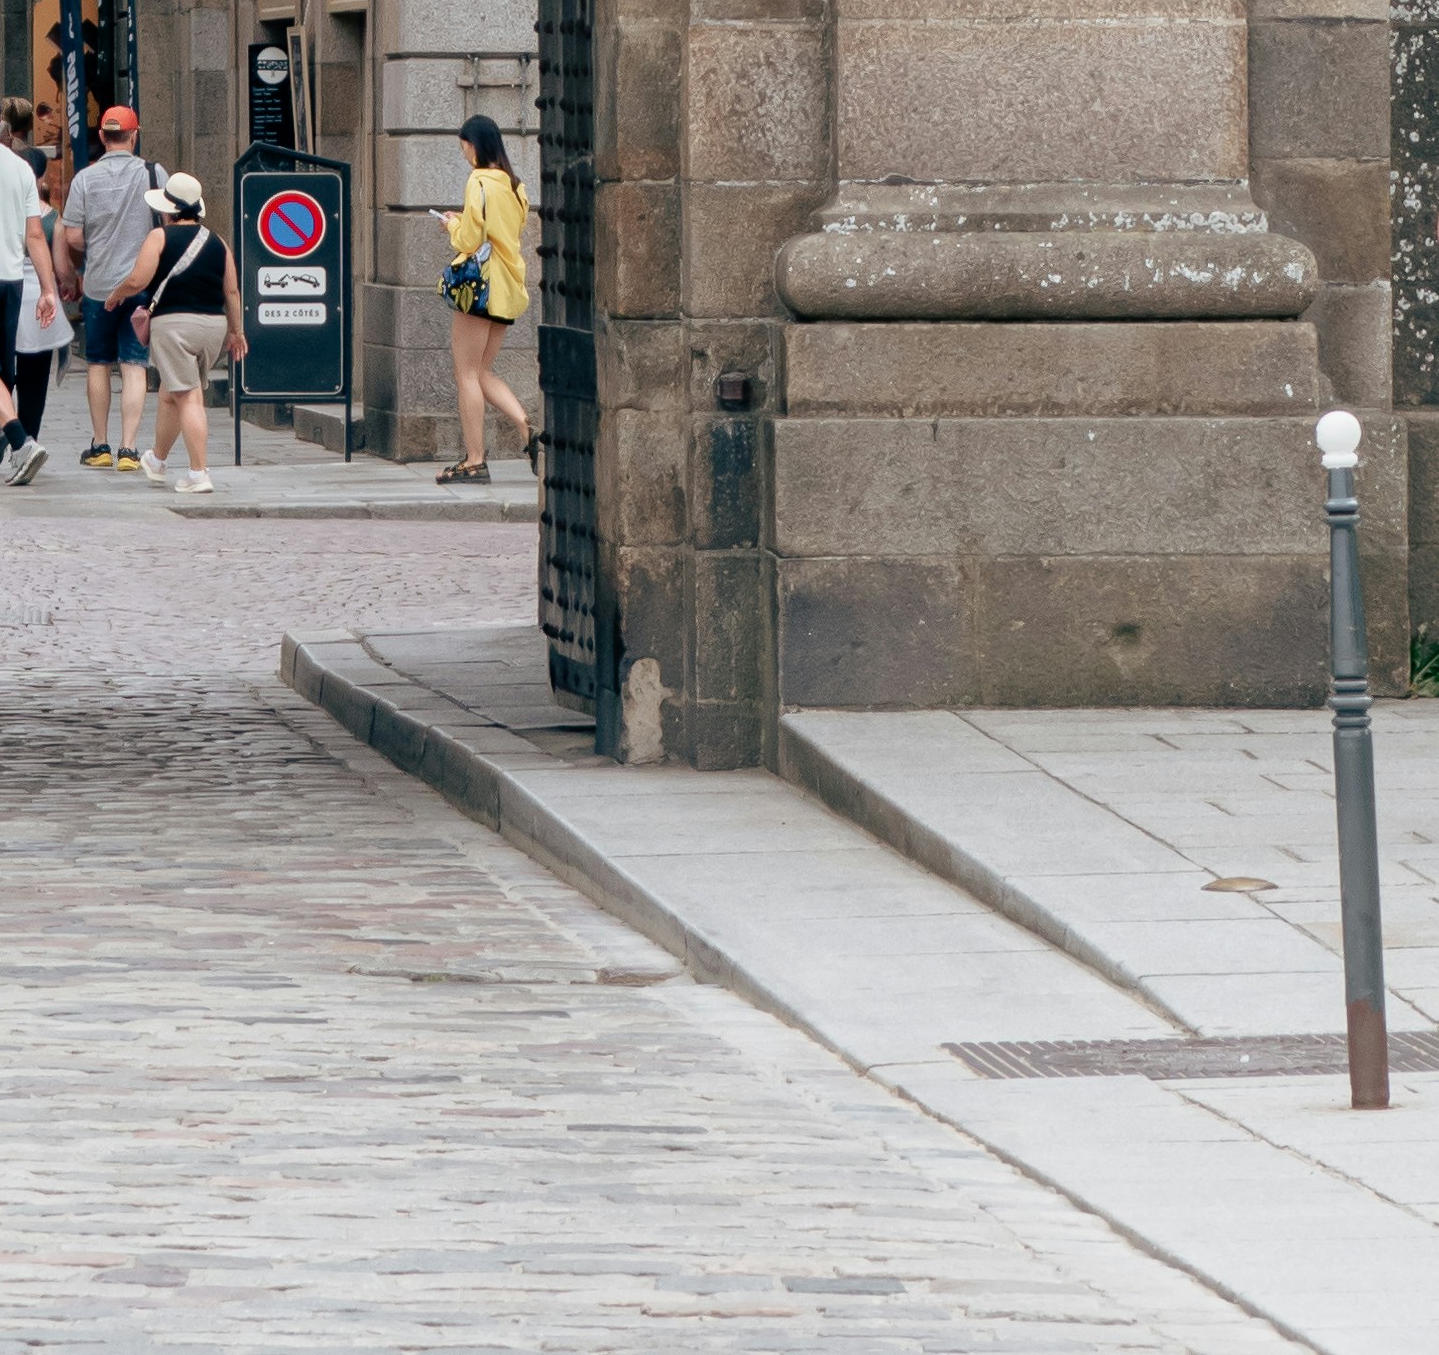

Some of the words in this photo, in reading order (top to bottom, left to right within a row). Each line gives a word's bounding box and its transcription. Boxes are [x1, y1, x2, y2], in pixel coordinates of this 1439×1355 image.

[264, 310, 281, 318] DES
[284, 310, 290, 318] 2
[292, 308, 320, 318] CÔTÉS
